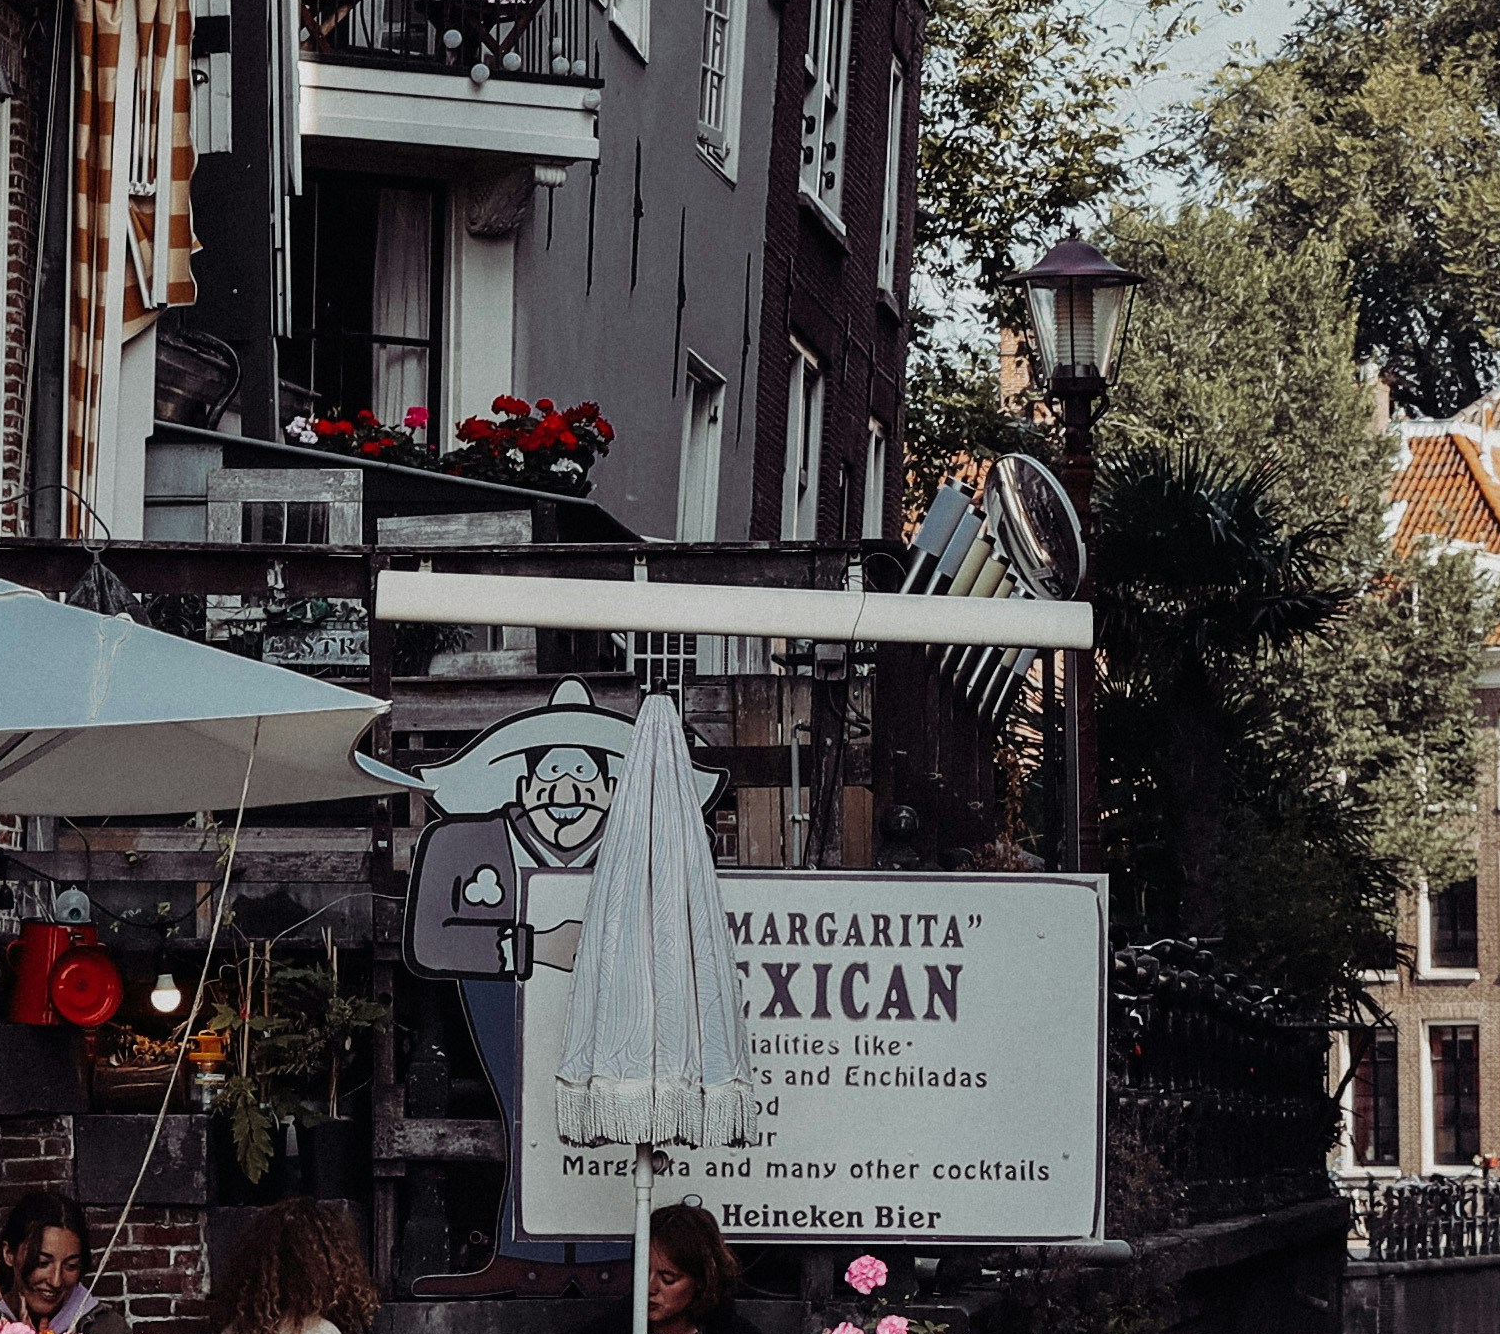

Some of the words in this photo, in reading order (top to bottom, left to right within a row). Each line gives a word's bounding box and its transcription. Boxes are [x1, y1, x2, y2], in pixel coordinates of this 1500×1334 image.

[785, 1066, 830, 1086] and
[845, 1066, 988, 1088] Enchiladas
[705, 1158, 750, 1177] and
[766, 1162, 836, 1180] many
[850, 1159, 920, 1180] other
[932, 1159, 1050, 1181] cocktails
[721, 1203, 864, 1229] Heineken
[874, 1205, 942, 1229] Bier
